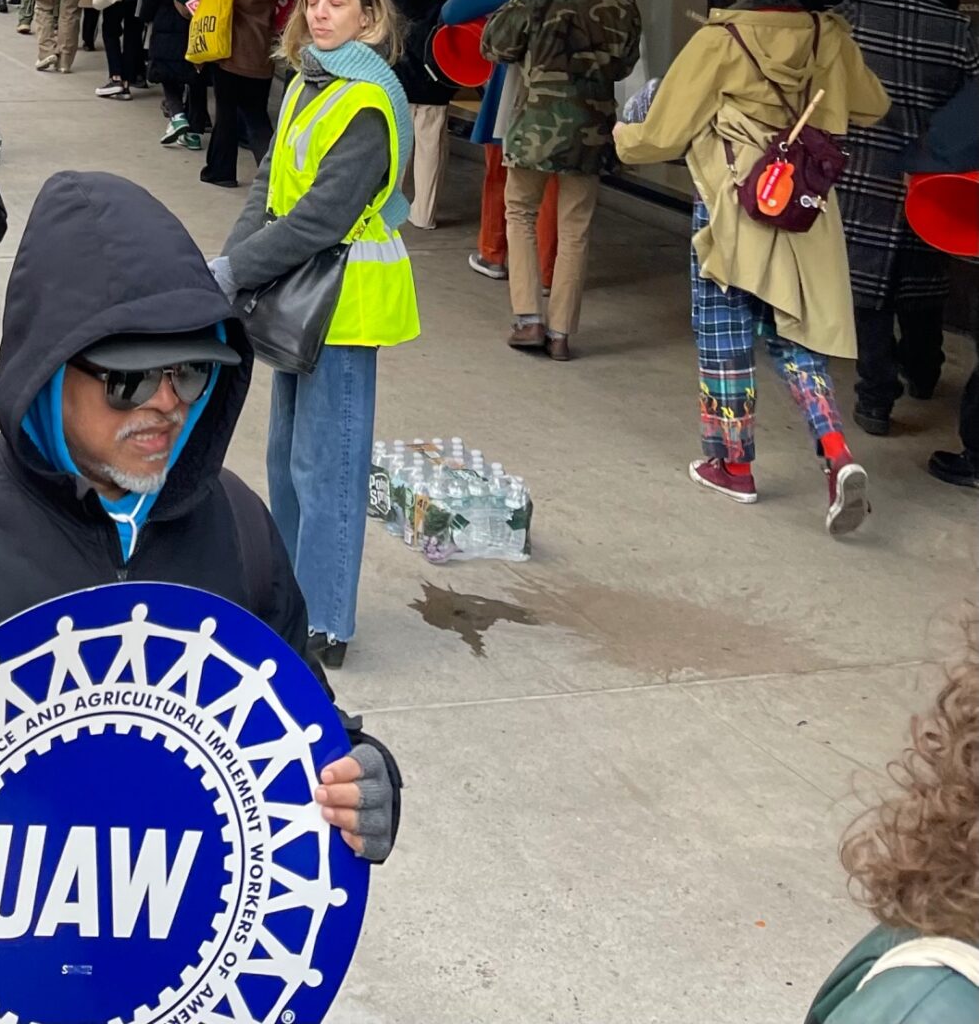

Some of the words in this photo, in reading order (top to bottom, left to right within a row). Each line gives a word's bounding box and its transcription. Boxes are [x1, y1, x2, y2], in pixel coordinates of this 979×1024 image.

[25, 703, 67, 734] AND
[74, 690, 205, 735] AGRICULTURAL
[204, 730, 262, 833] IMPLEMENT
[234, 843, 264, 945] WORKERS
[218, 952, 237, 980] OF
